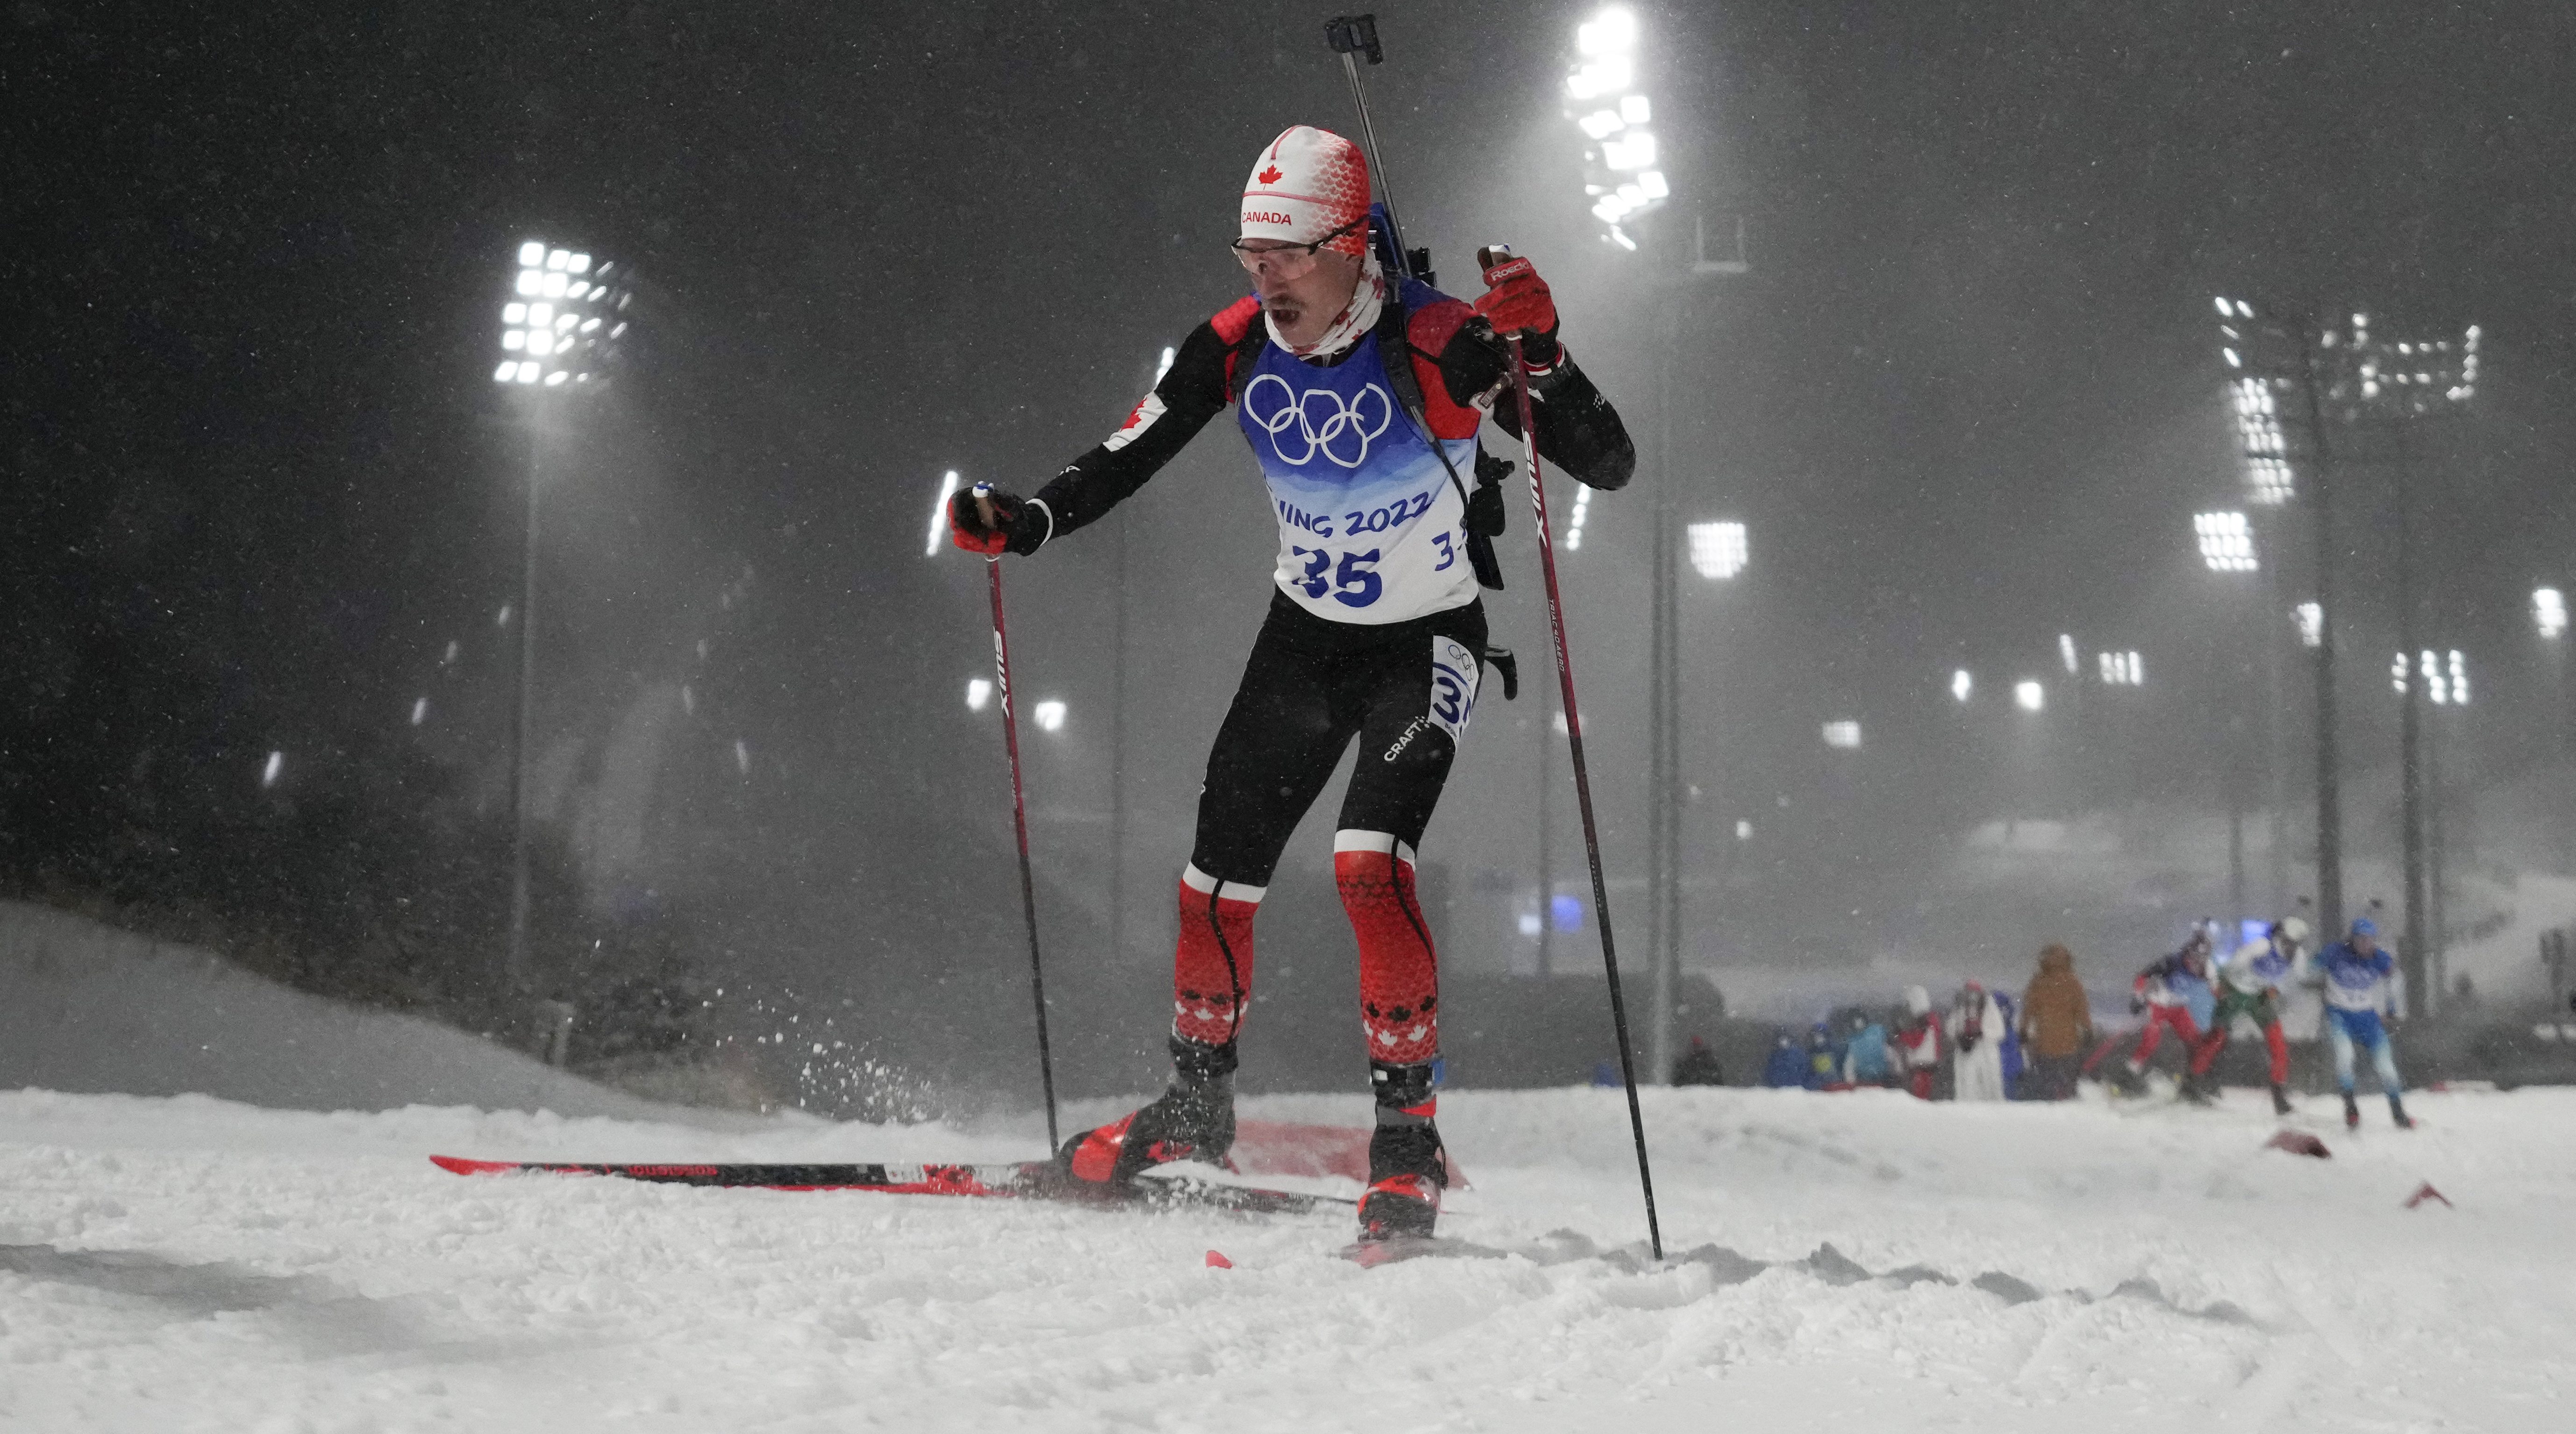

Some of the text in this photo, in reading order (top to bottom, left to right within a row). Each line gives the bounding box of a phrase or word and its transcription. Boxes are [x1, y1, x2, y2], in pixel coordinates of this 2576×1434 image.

[1242, 211, 1292, 226] CANADA
[1344, 491, 1434, 536] 2022
[1521, 426, 1548, 548] SWIX
[1292, 545, 1382, 608] 35
[1431, 530, 1466, 571] 3
[1548, 599, 1558, 628] TRIAC
[1556, 644, 1564, 673] AERO
[992, 625, 1010, 718] SWIX
[1384, 721, 1421, 761] CRAFT
